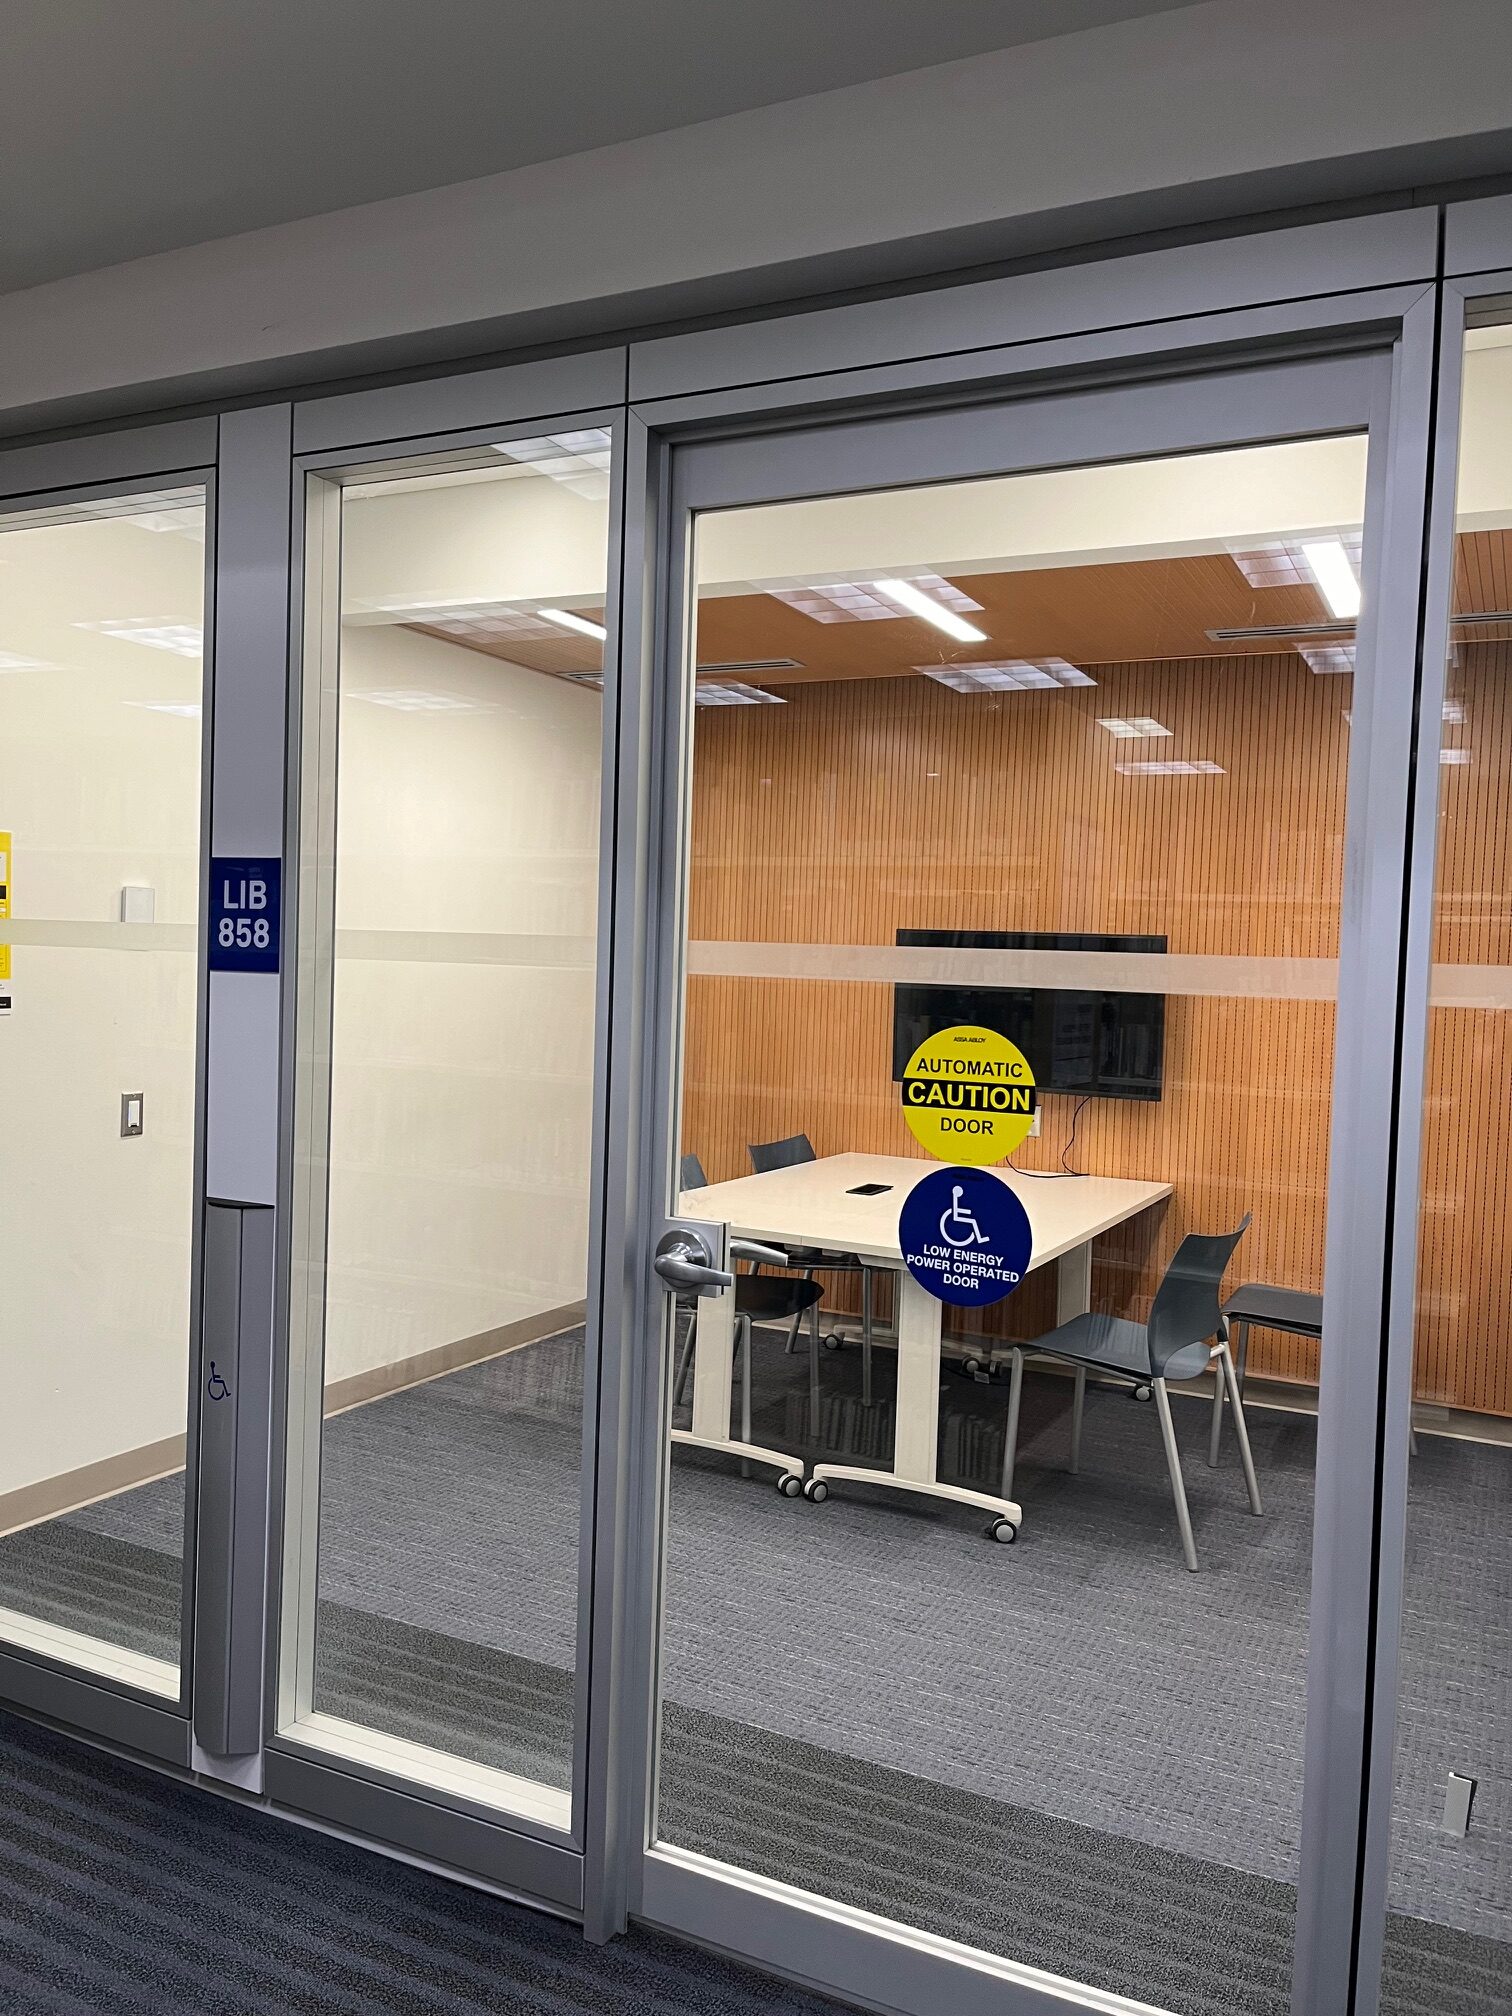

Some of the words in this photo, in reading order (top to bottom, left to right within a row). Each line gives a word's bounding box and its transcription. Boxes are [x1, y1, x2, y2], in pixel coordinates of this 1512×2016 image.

[223, 880, 267, 910] LIB
[218, 917, 270, 949] 858
[916, 1058, 1023, 1078] AUTOMATIC
[908, 1081, 1030, 1111] CAUTION
[940, 1117, 994, 1135] DOOR
[907, 1254, 950, 1271] POWER
[953, 1262, 1020, 1283] OPERATED
[923, 1244, 951, 1258] LOW
[953, 1249, 1004, 1267] ENERGY
[943, 1274, 979, 1289] DOOR
